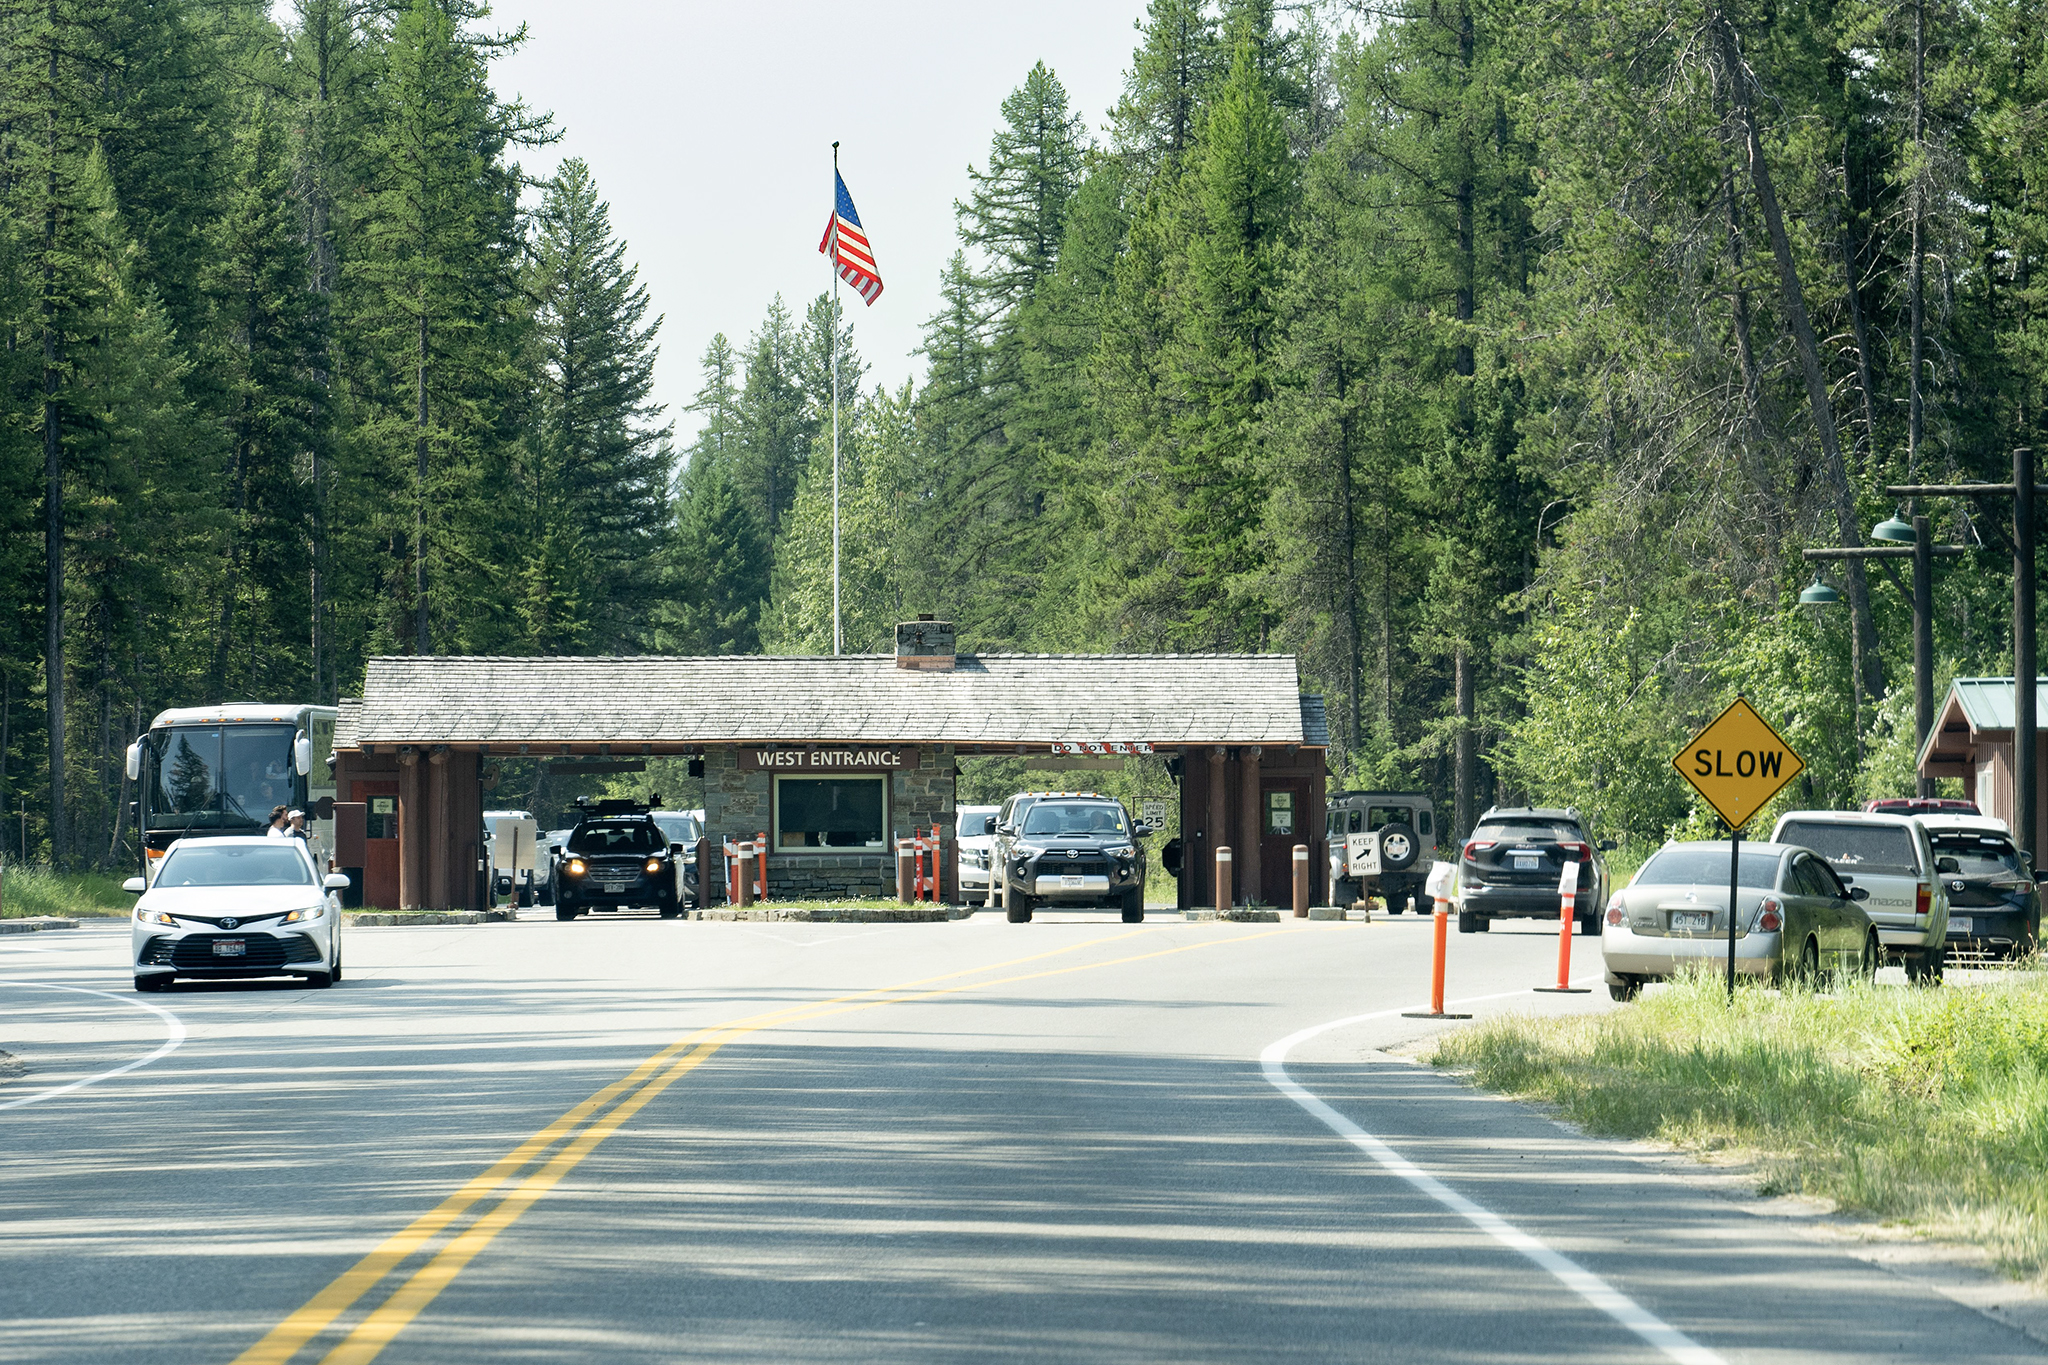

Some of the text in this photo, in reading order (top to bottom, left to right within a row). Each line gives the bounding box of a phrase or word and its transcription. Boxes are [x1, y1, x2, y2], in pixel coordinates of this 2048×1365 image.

[1054, 744, 1153, 752] DO NOT ENTER
[756, 751, 901, 766] WEST ENTRANCE
[1693, 749, 1783, 778] SLOW
[1145, 816, 1164, 828] 25
[1352, 837, 1374, 846] KEEP
[1352, 861, 1377, 871] RIGHT
